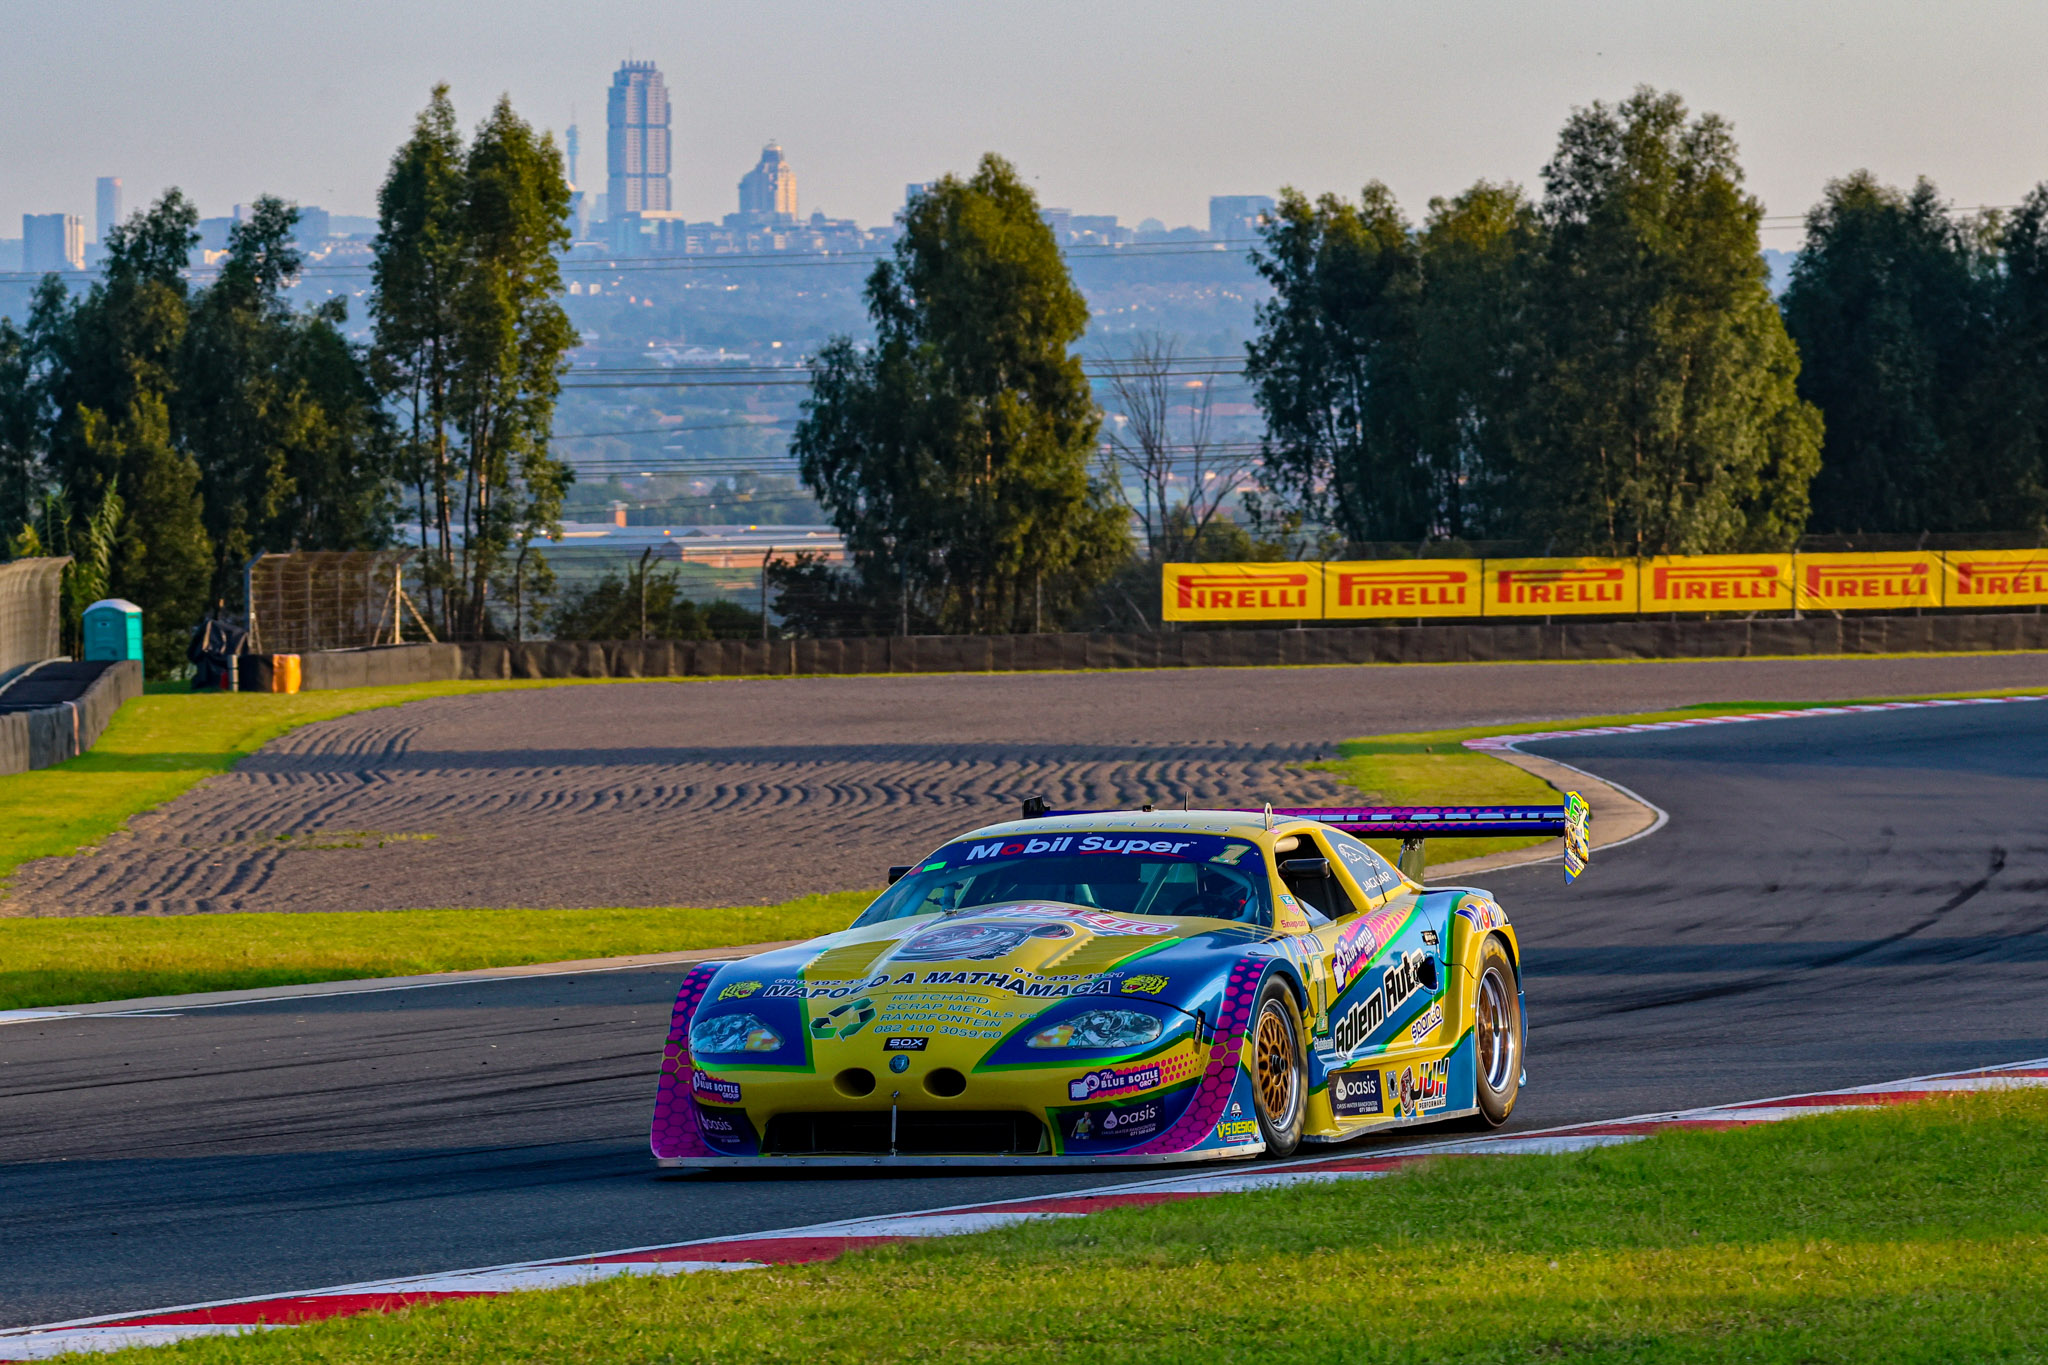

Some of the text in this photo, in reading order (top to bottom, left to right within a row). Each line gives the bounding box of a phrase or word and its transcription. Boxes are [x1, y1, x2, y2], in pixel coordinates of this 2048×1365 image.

[1177, 573, 1308, 608] PIRELLI
[1338, 571, 1467, 606] PIRELLI
[1497, 568, 1624, 603] PIRELLI
[1653, 565, 1778, 600] PIRELLI
[1806, 563, 1929, 597] PIRELLI
[966, 837, 1190, 861] Mobil Super
[1209, 844, 1252, 866] 1
[1362, 871, 1392, 892] JAGUAR
[893, 971, 916, 985] A
[921, 971, 1112, 997] MATHAMAGA
[1013, 967, 1044, 981] 010
[1048, 972, 1080, 982] 492
[892, 994, 990, 1004] RIETCHARD
[1335, 948, 1424, 1058] Adlem Aut
[879, 1013, 1003, 1028] RANDFONTEIN
[885, 1003, 944, 1011] SCRAP
[947, 1004, 1014, 1019] METALS
[873, 1024, 1003, 1039] 082 410 3059/60
[1411, 1004, 1441, 1043] sparco
[889, 1038, 924, 1046] SOX
[1101, 1071, 1113, 1080] The
[1101, 1070, 1158, 1089] BLUE BOTTLE
[1139, 1078, 1159, 1088] GROP
[1347, 1075, 1376, 1096] oasis
[714, 1083, 739, 1094] BOTTLE
[1119, 1104, 1156, 1125] oasis
[1232, 1120, 1258, 1134] DESIGN
